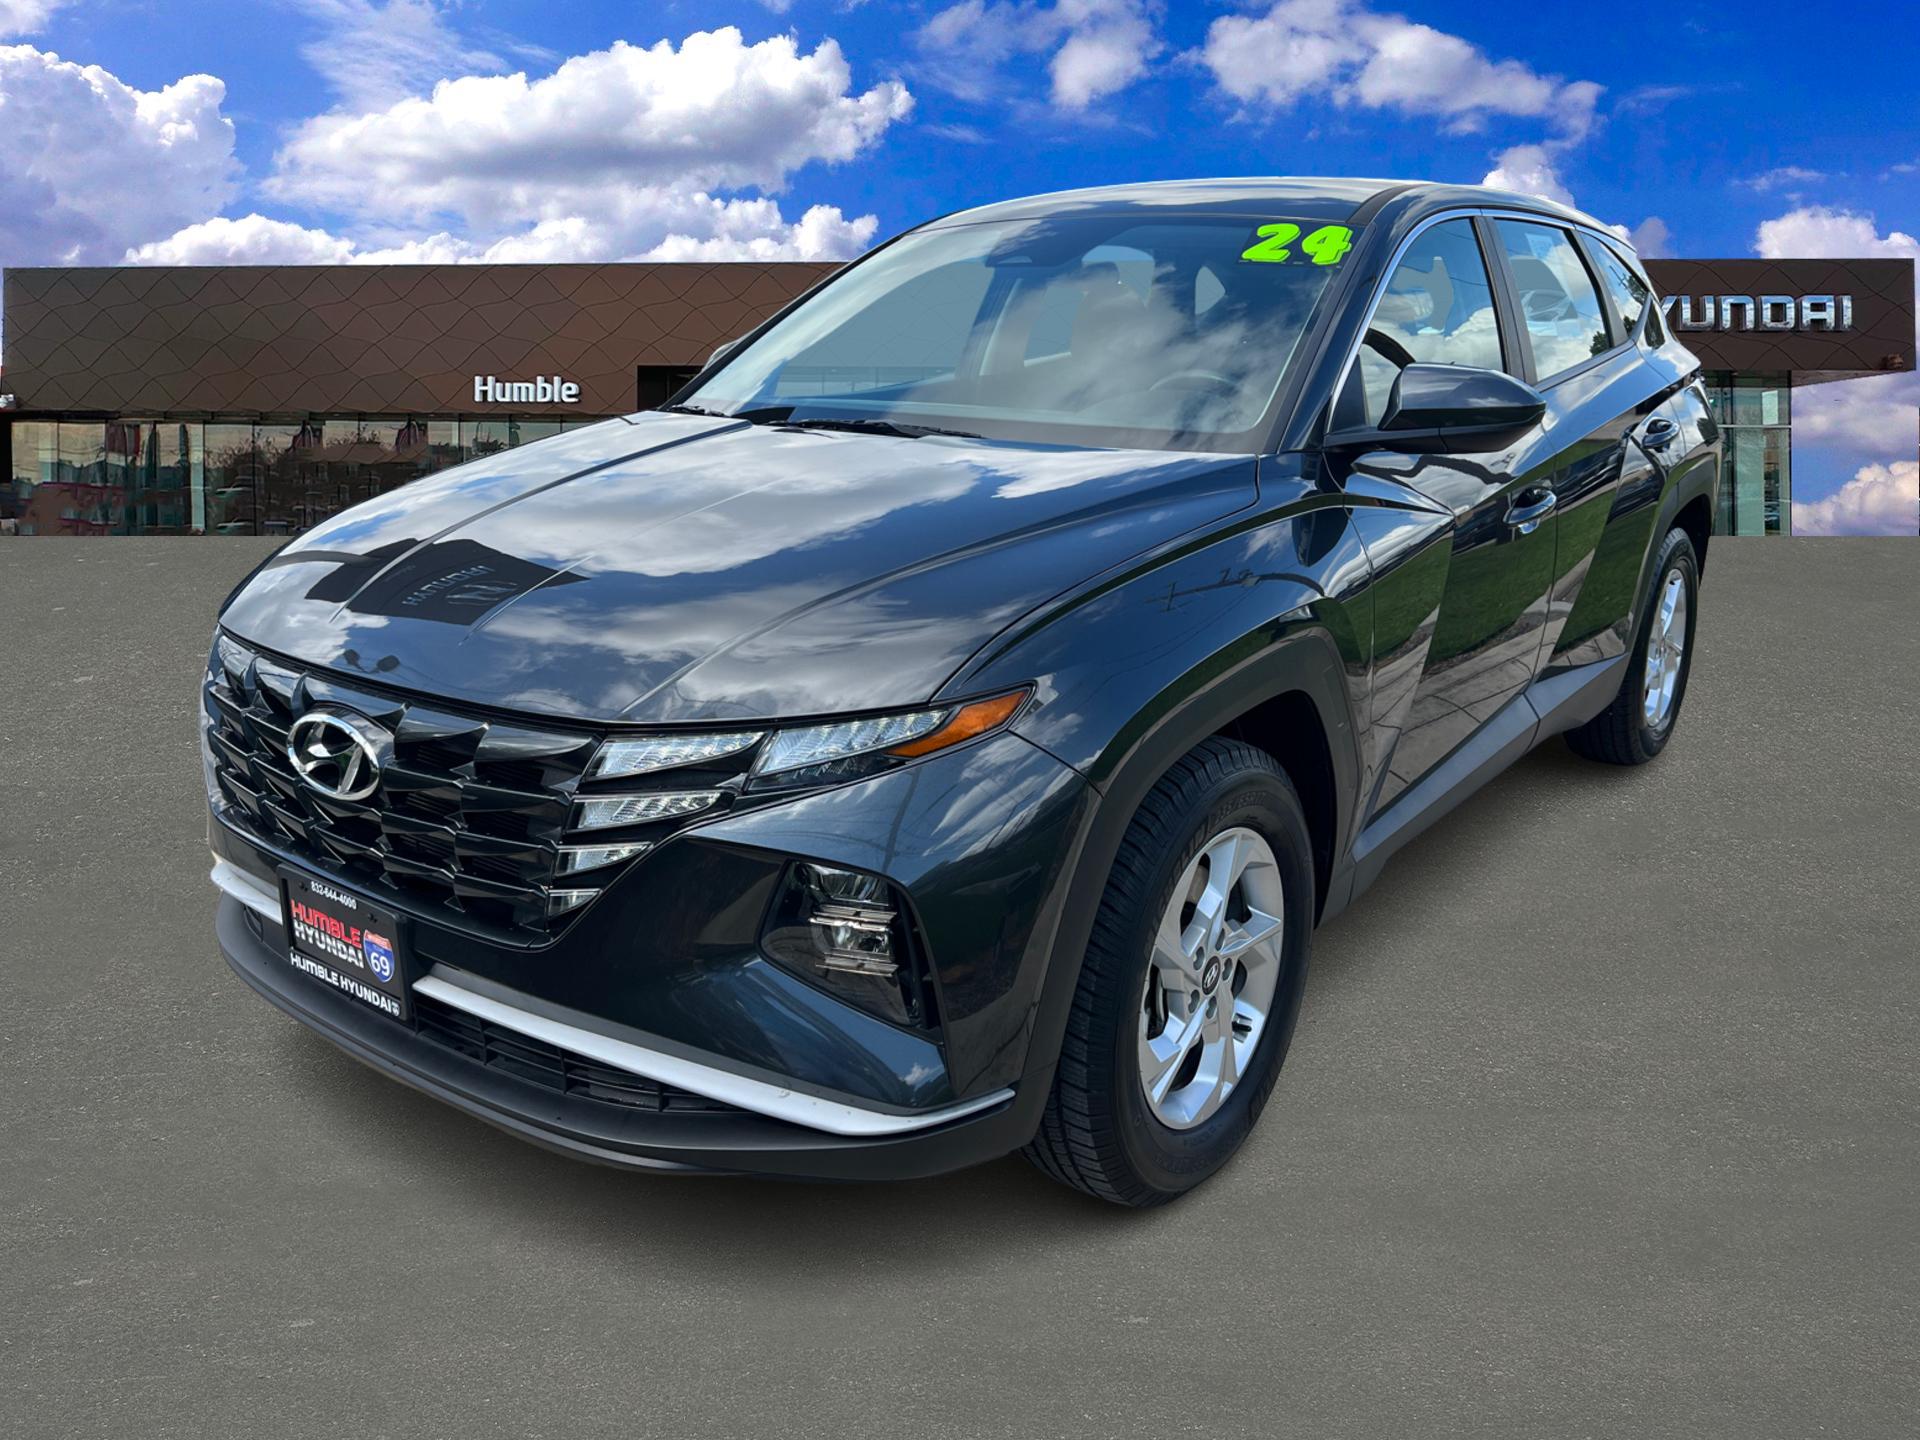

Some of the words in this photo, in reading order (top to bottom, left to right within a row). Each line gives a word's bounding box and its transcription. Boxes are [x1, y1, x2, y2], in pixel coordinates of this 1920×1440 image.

[1242, 223, 1353, 265] 24
[474, 375, 580, 403] Humble
[291, 899, 362, 949] HUMBLE
[294, 919, 364, 968] HYUNDAI
[290, 952, 339, 986] HUMBLE
[339, 975, 392, 1013] HYUNDAI
[370, 952, 390, 977] 69
